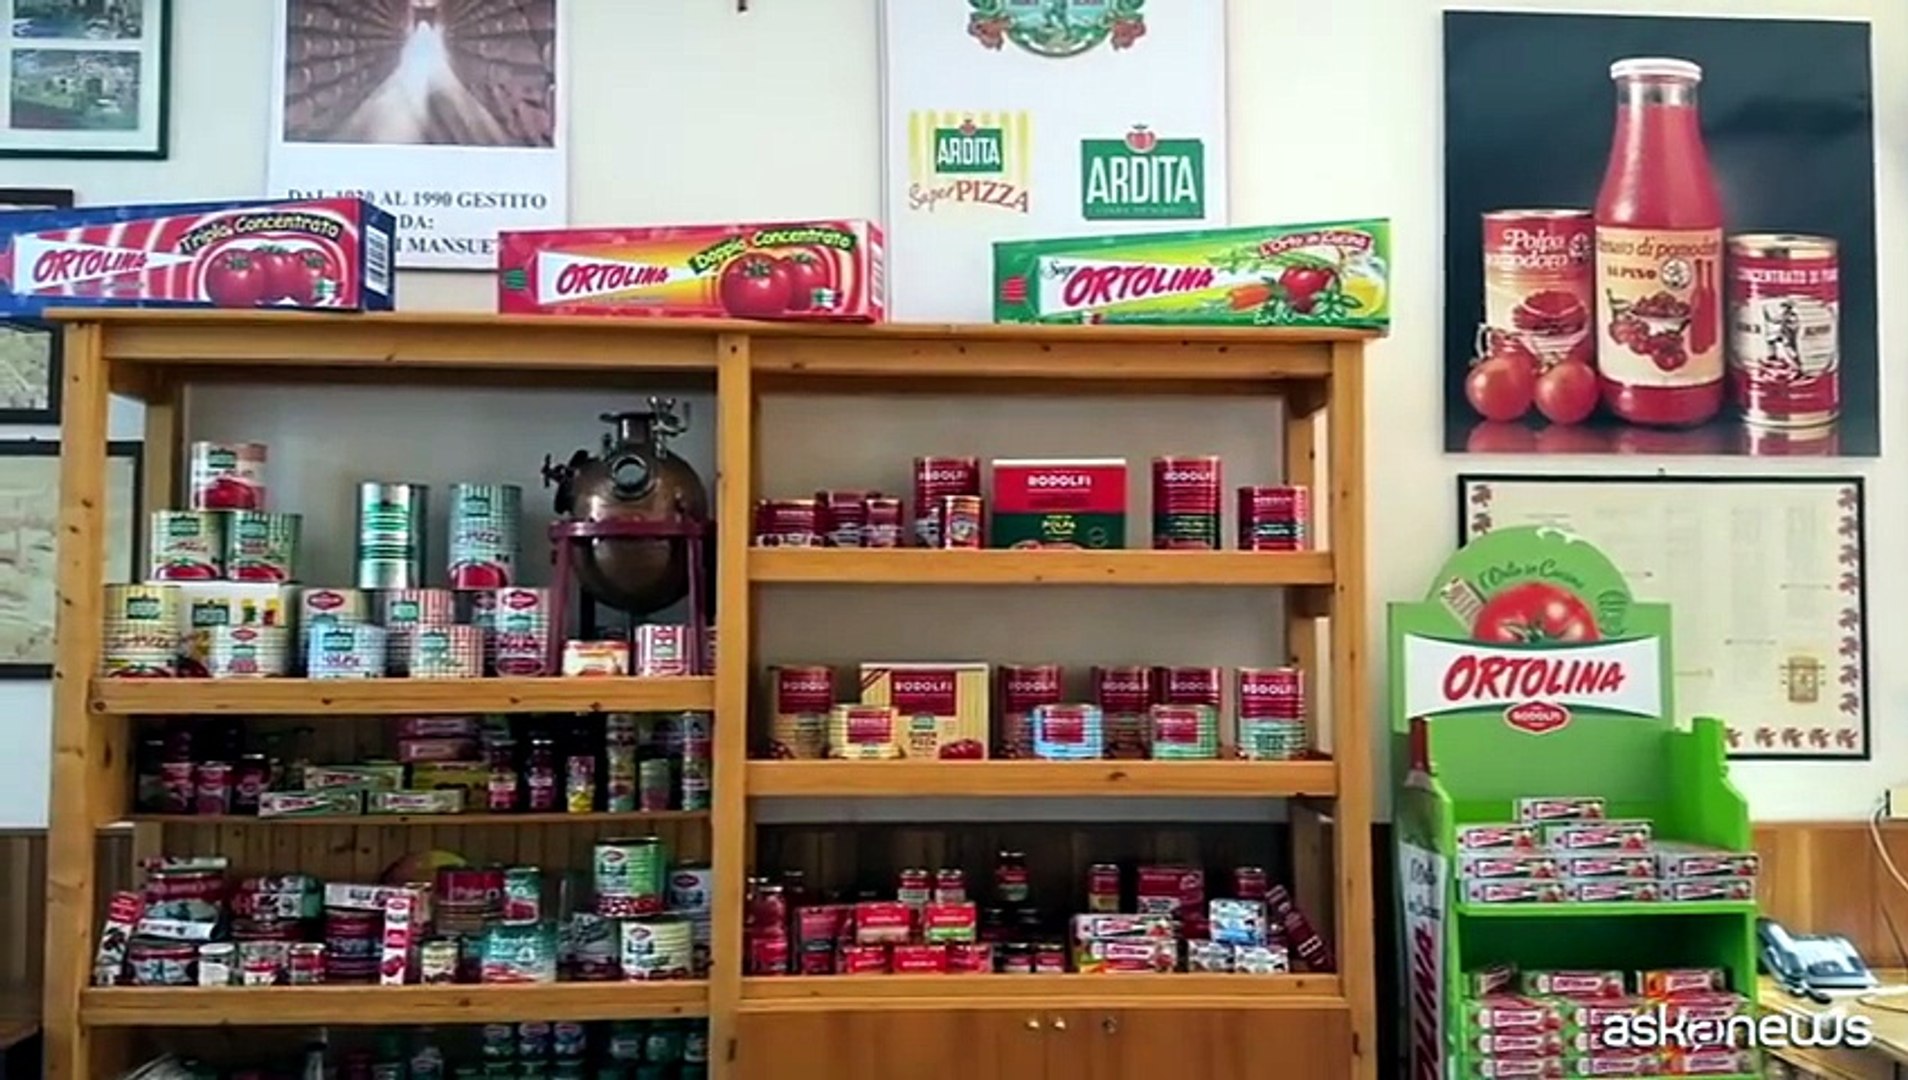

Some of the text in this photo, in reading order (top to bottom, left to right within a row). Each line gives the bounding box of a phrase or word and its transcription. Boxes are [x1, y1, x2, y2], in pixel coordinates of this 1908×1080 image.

[938, 137, 1000, 165] ARDITA
[1086, 156, 1198, 204] ARDITA
[380, 190, 406, 206] AL
[413, 191, 453, 208] 1990
[456, 191, 548, 209] GESTITO
[956, 180, 1028, 213] PIZZA
[234, 215, 339, 238] Concentrato
[400, 213, 434, 230] DA:
[408, 236, 499, 255] MANSUE
[752, 229, 851, 249] Concentrato
[1499, 228, 1566, 253] Polpa
[33, 249, 148, 284] ORTOLINA
[556, 263, 669, 295] ORTOLINA
[1064, 265, 1213, 306] ORTOLINA
[1028, 474, 1091, 486] RODOLFI
[894, 680, 953, 692] RODOLFI
[1443, 656, 1625, 701] ORTOLINA
